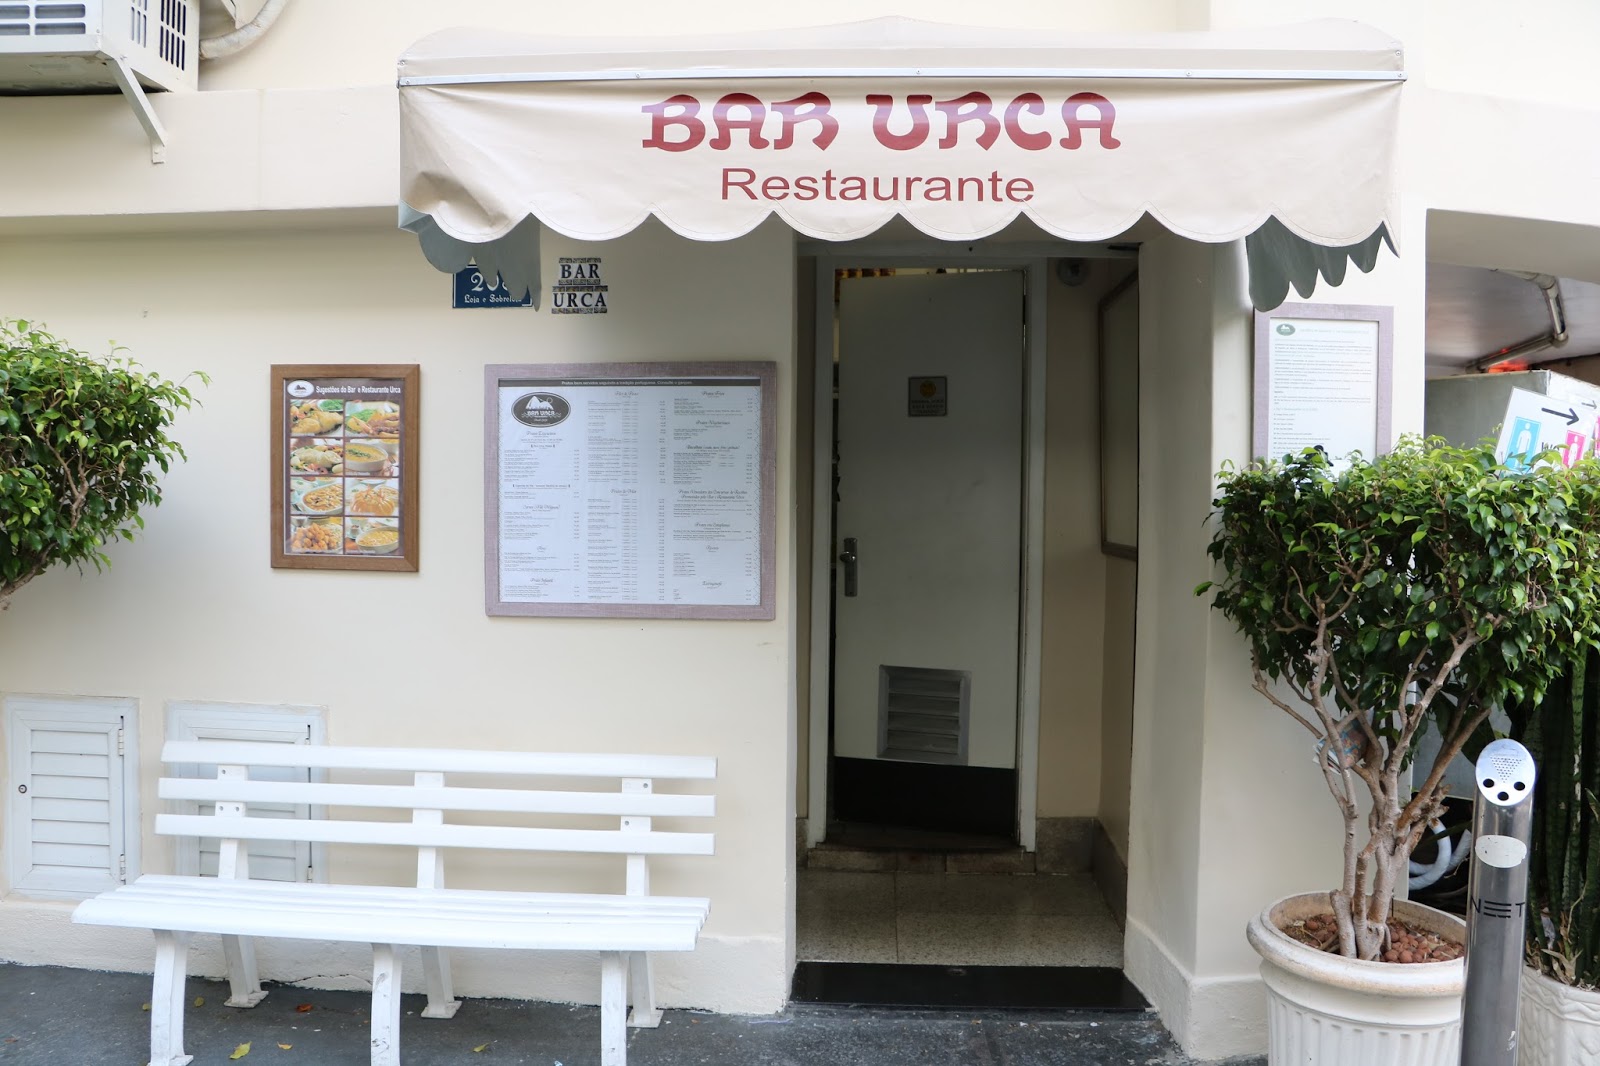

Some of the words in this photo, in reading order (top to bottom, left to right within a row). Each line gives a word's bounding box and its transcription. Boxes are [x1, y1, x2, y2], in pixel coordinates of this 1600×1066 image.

[641, 91, 839, 152] BAR
[866, 91, 1121, 152] URCA
[721, 167, 1034, 202] Restaurante
[560, 263, 600, 279] BAR
[553, 292, 607, 308] URCA
[316, 386, 340, 395] Sugestões
[340, 386, 347, 394] do
[347, 386, 356, 394] Bar
[361, 386, 389, 394] Restaurante
[389, 386, 401, 394] Urca
